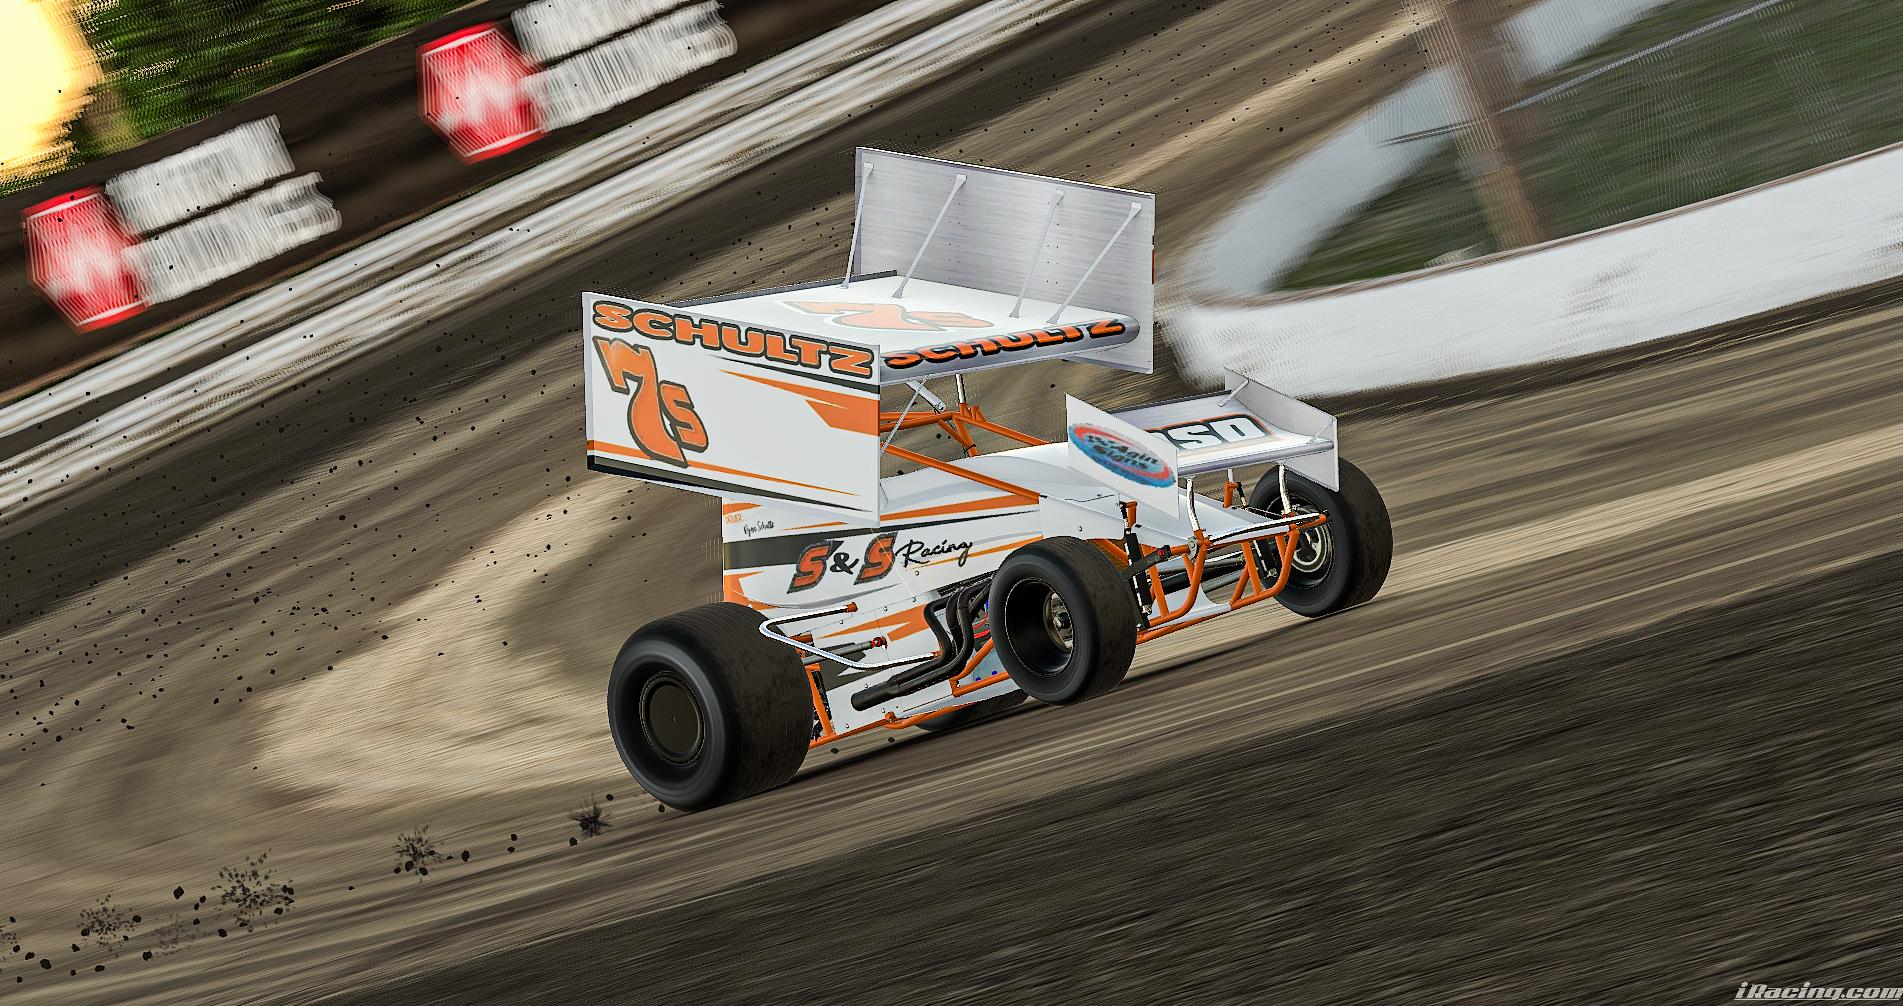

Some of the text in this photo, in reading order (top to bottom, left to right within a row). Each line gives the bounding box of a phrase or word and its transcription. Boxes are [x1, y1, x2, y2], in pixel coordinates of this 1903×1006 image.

[592, 300, 873, 378] SCHULTZ
[880, 318, 1126, 369] SCHULTZ
[787, 531, 973, 594] S & S Racing
